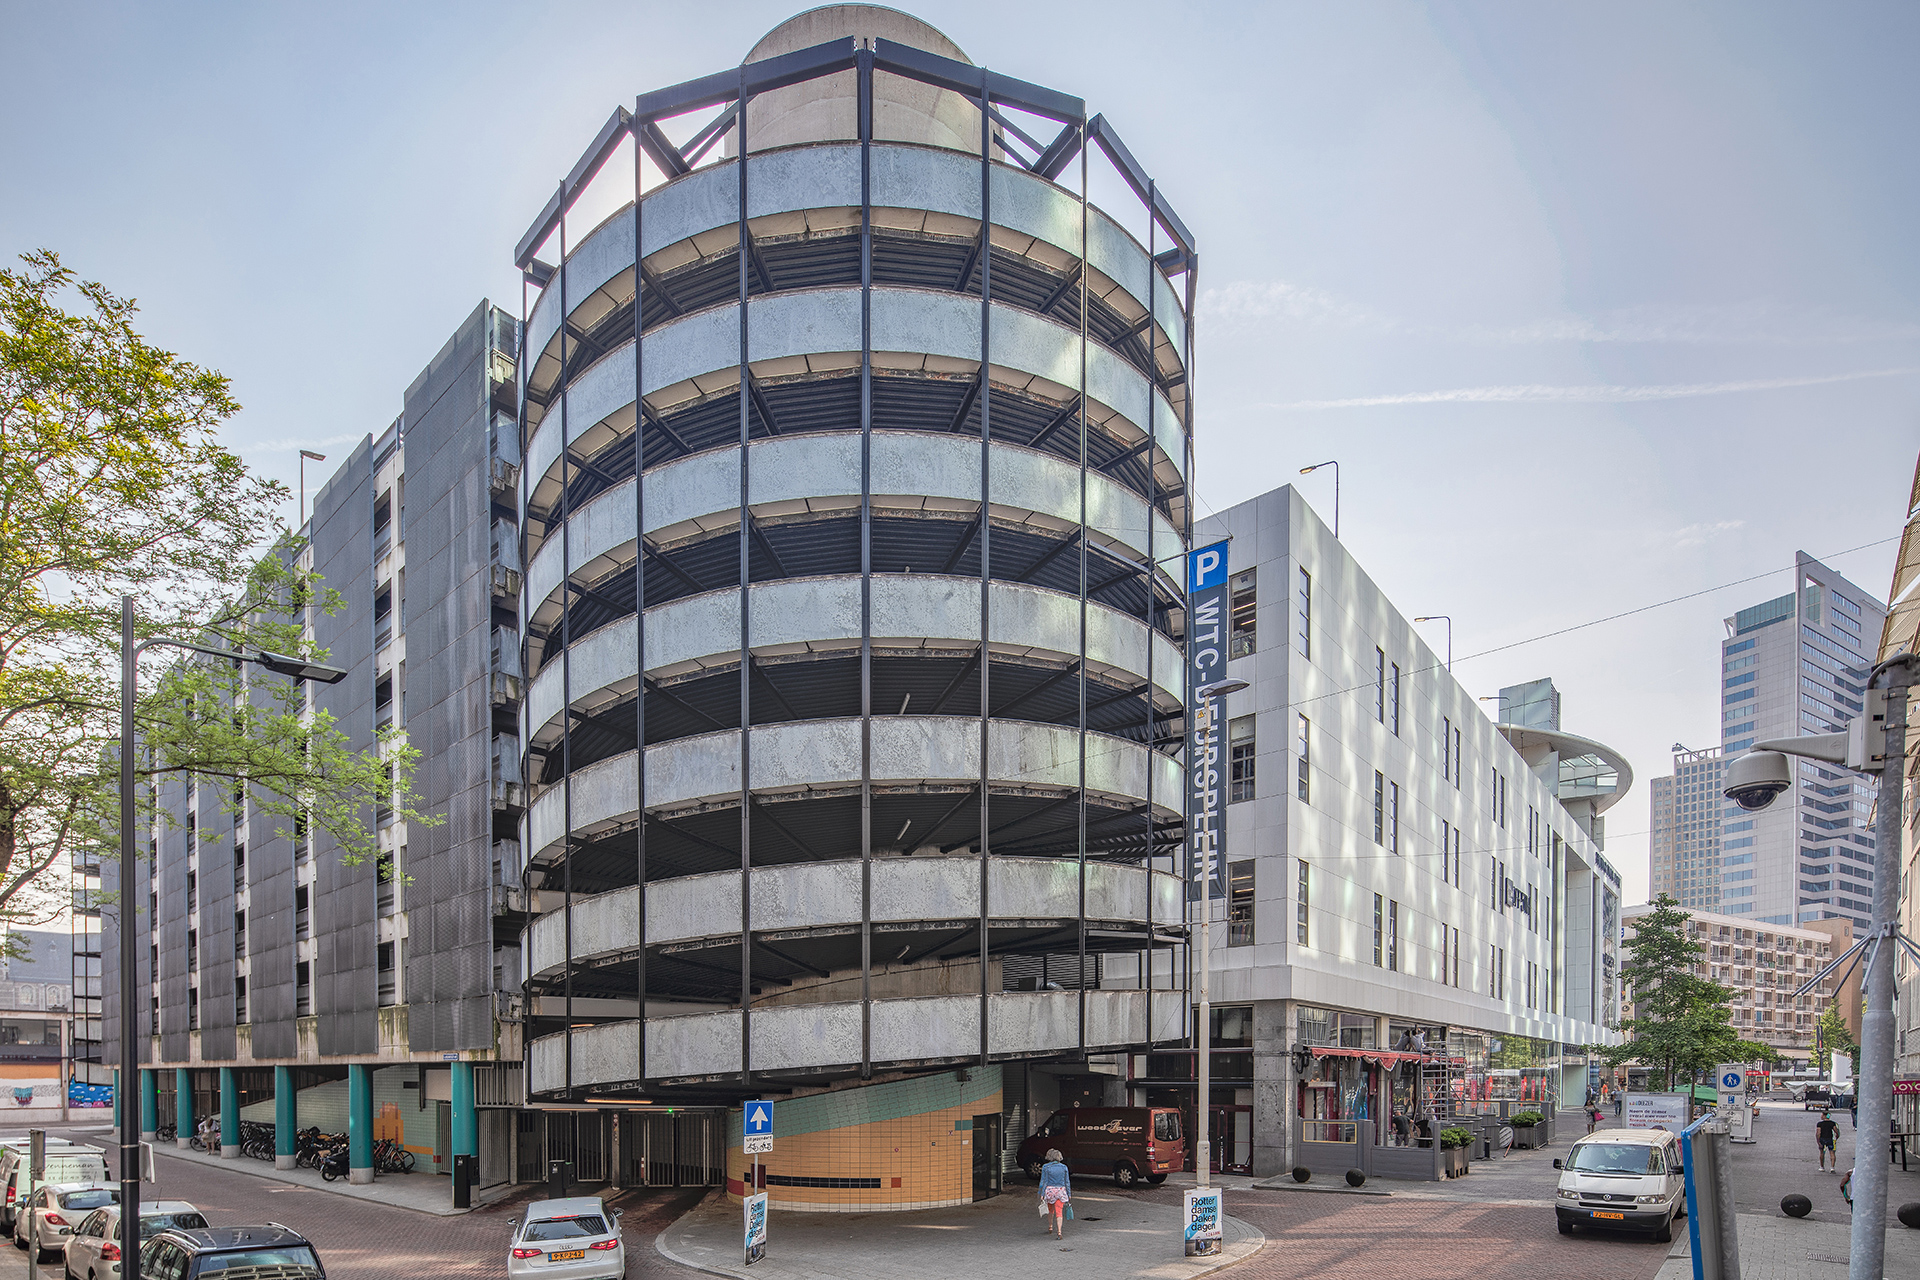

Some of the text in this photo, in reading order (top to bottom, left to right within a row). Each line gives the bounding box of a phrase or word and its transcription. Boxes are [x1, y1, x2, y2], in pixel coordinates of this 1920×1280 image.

[1196, 550, 1220, 587] P
[1190, 1196, 1215, 1206] Rotter
[1190, 1205, 1217, 1214] damse
[1190, 1214, 1216, 1223] Daken
[1191, 1223, 1216, 1232] dagen
